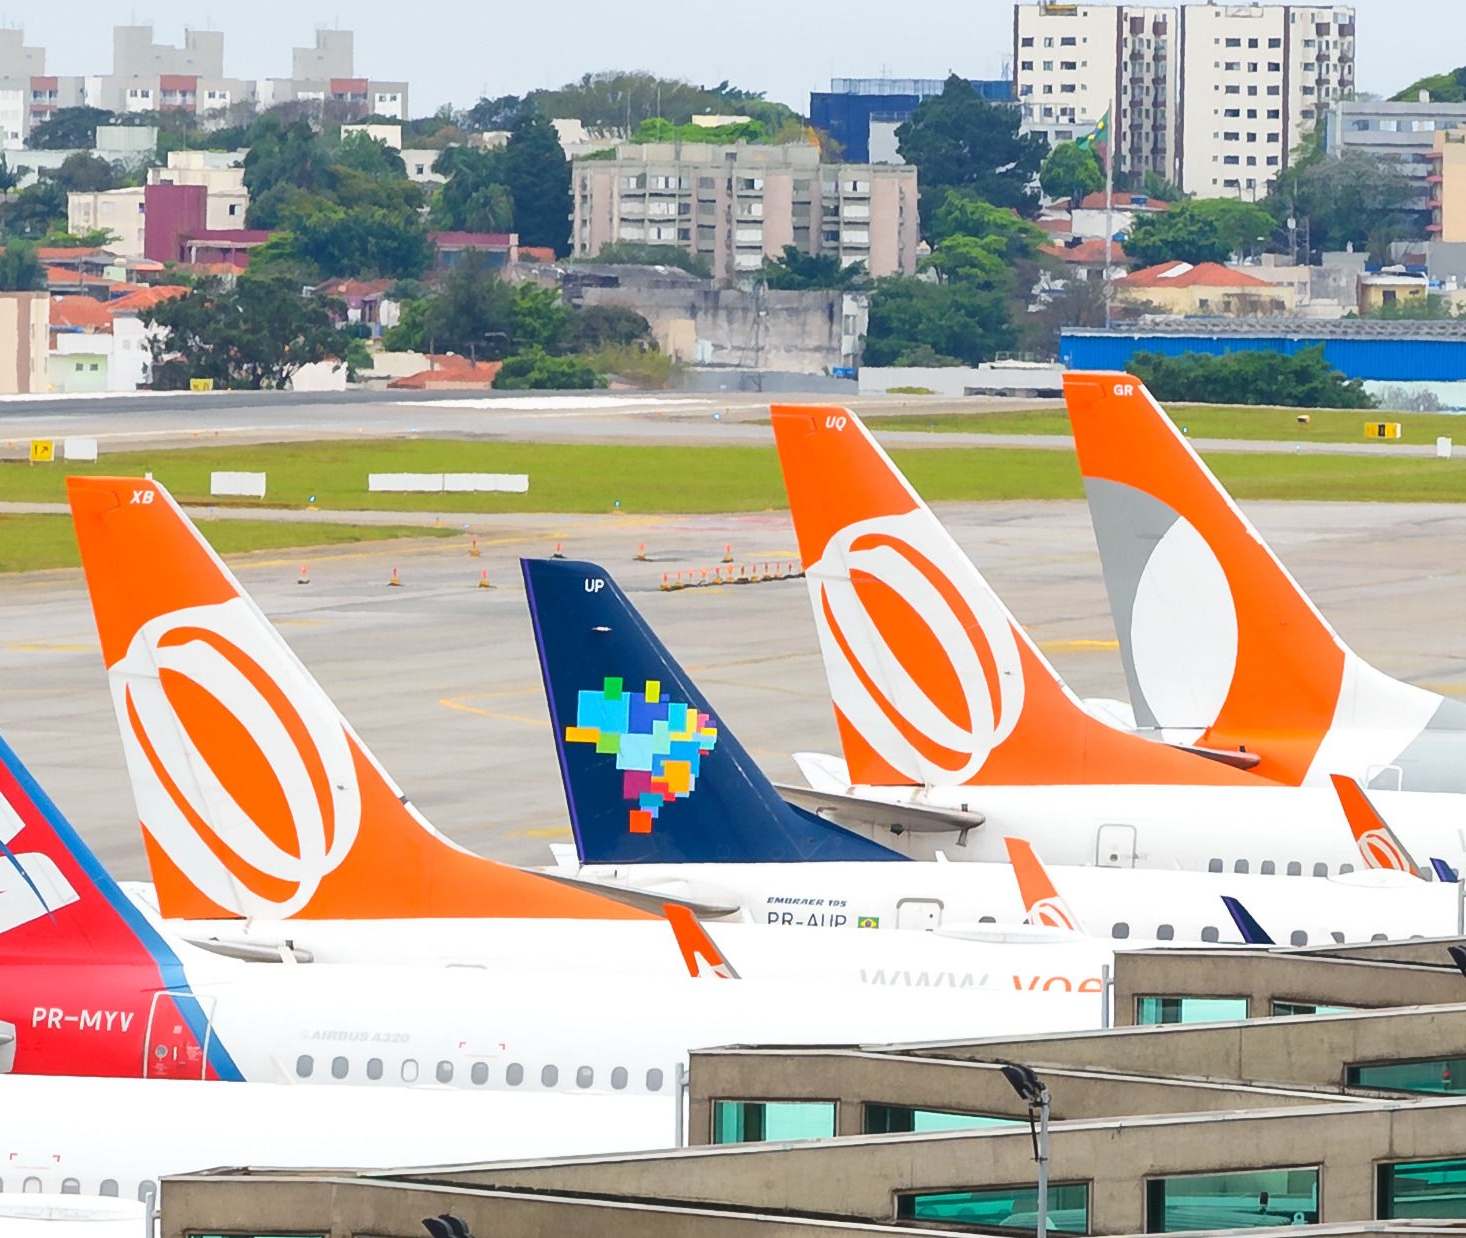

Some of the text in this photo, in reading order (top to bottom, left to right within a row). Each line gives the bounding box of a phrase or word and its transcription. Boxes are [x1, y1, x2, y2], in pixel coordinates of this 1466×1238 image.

[1113, 383, 1134, 397] GR
[825, 415, 847, 432] UQ
[129, 490, 155, 505] XB
[584, 578, 605, 593] UP
[32, 1007, 135, 1033] PR-MYV
[310, 1029, 411, 1045] AIRBUS A320
